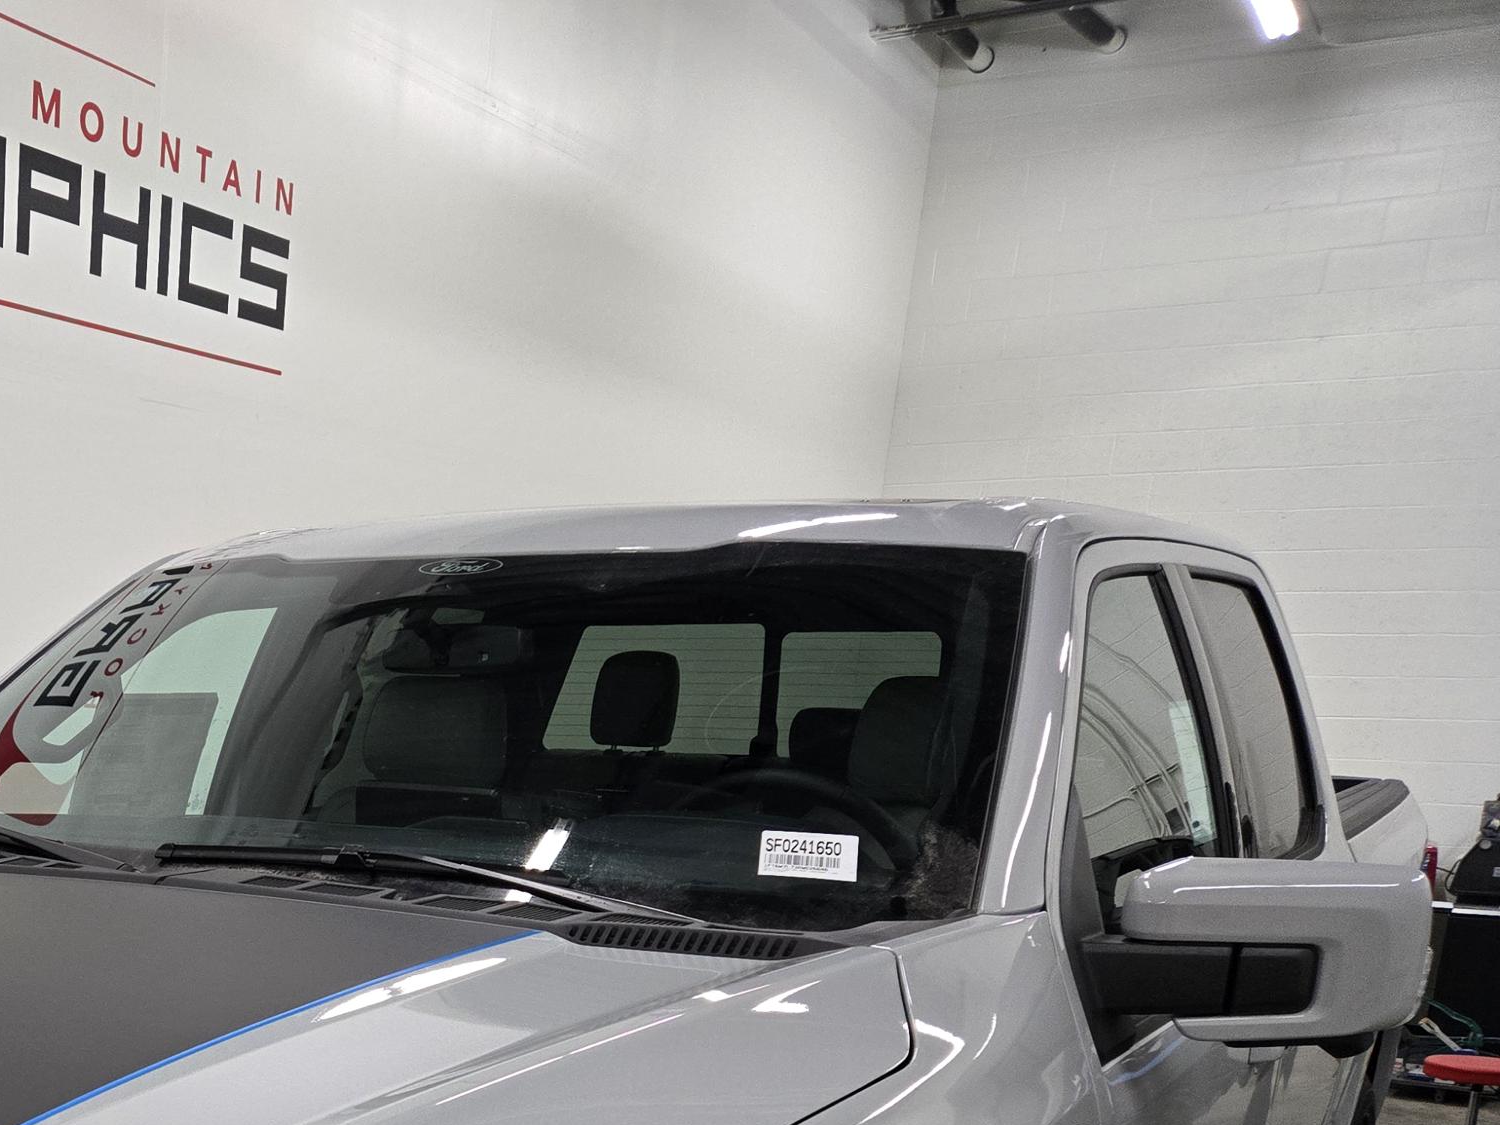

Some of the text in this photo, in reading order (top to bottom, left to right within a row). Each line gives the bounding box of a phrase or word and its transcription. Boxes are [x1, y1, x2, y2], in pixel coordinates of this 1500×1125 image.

[31, 79, 296, 216] MOUNTAIN
[431, 559, 490, 573] Ford
[765, 837, 842, 857] SF0241650
